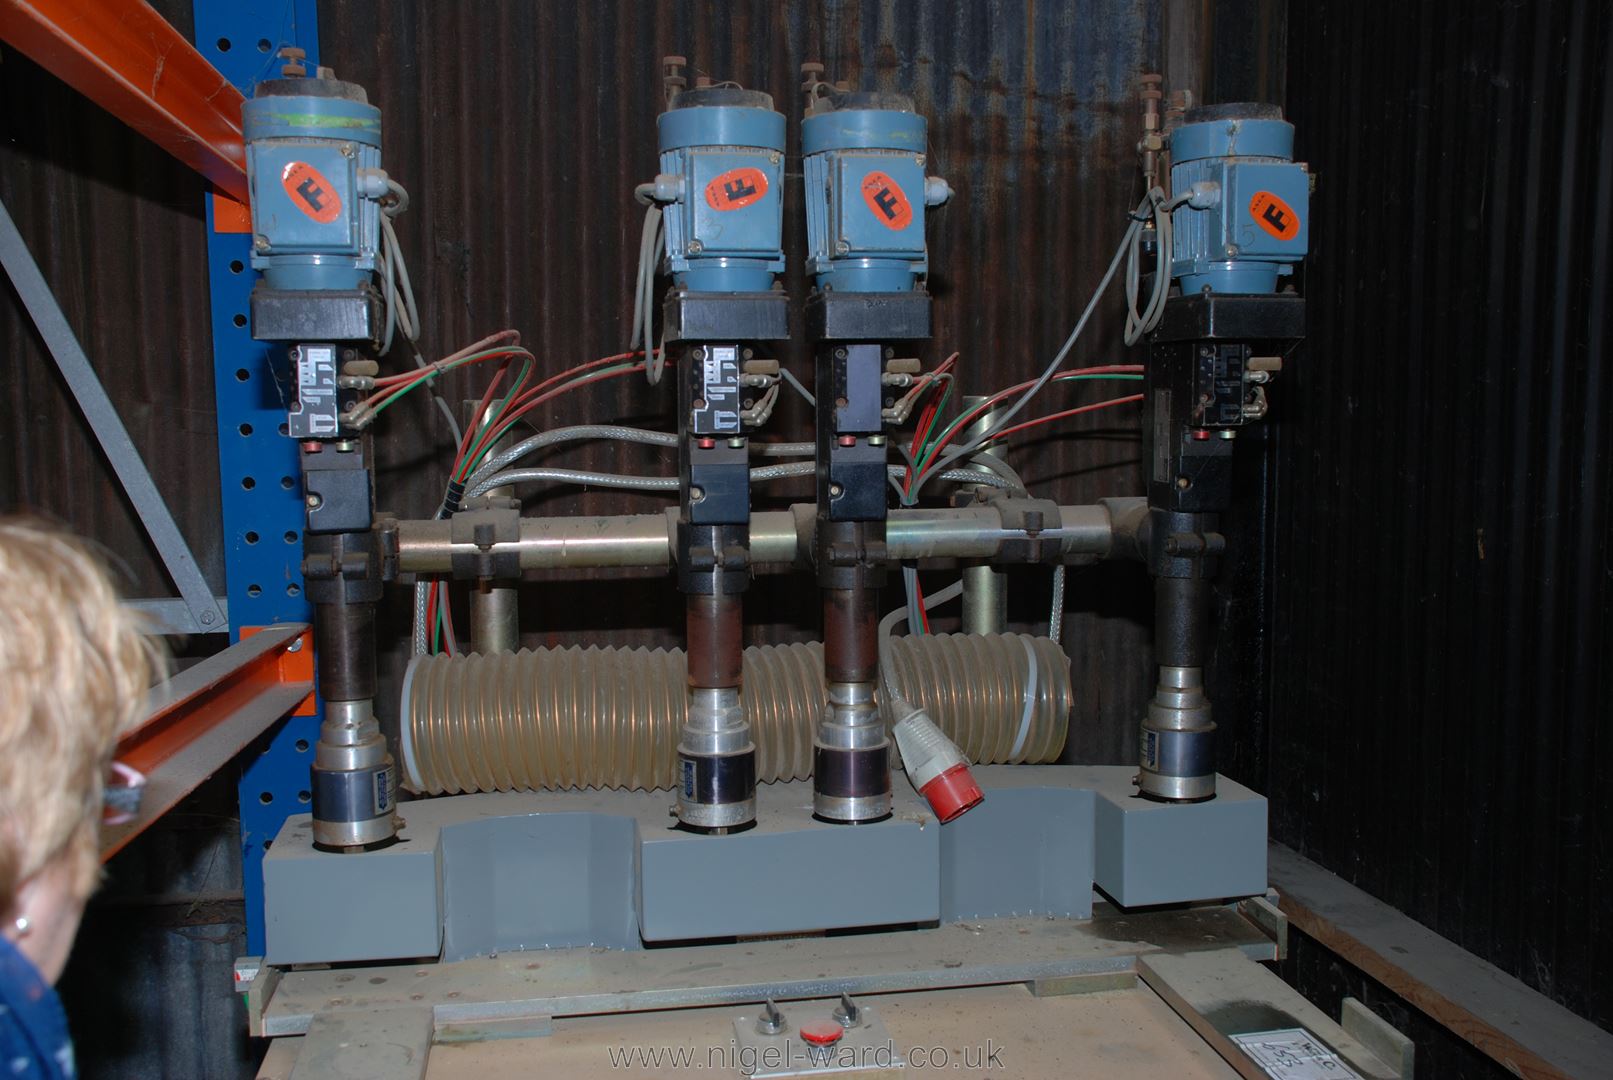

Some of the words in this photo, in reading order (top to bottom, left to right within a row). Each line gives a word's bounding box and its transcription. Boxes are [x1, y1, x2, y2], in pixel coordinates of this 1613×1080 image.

[296, 176, 324, 212] F
[724, 178, 757, 202] F
[873, 187, 897, 220] F
[1263, 203, 1286, 232] F
